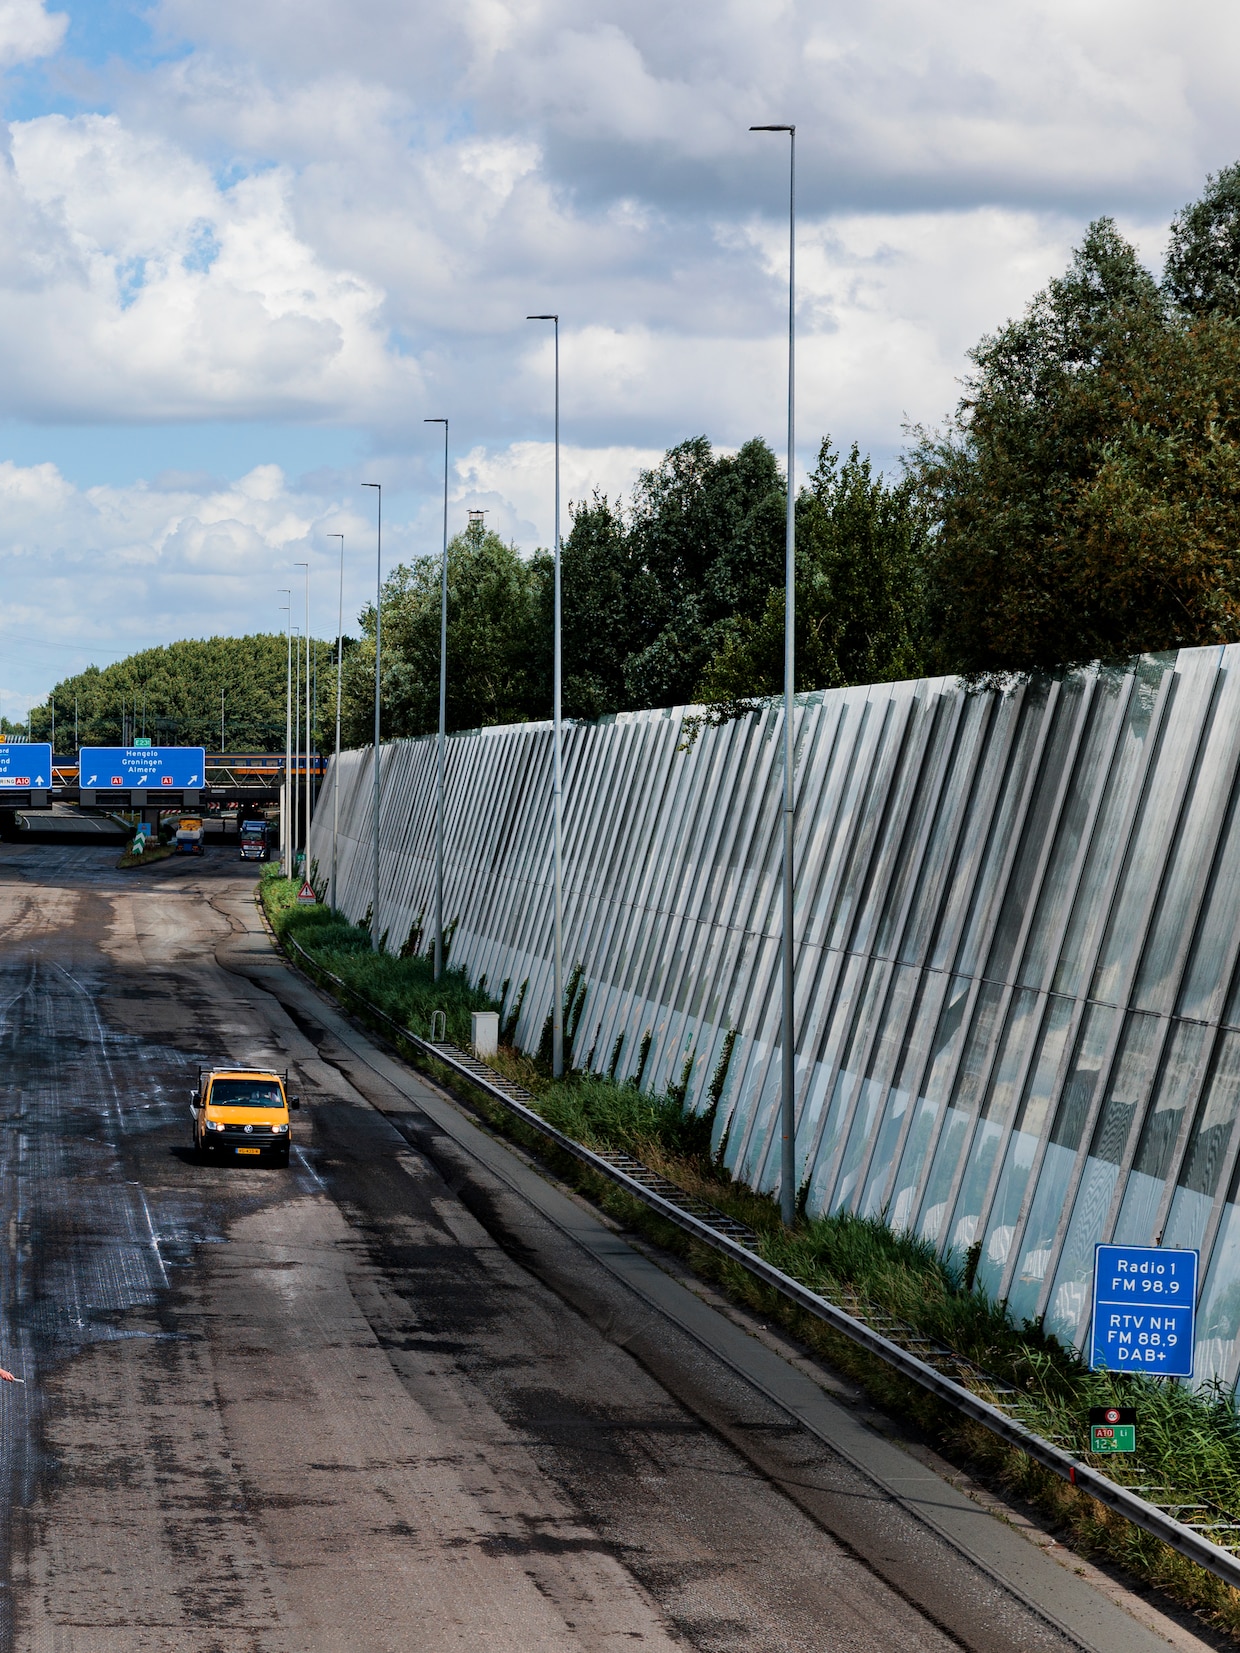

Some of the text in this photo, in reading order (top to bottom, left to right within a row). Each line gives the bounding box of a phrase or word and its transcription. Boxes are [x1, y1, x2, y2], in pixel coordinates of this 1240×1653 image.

[126, 750, 158, 758] Hengelo
[1117, 1259, 1176, 1275] Radio 1
[1112, 1278, 1136, 1292] FM
[1110, 1314, 1176, 1331] RTV NH
[1107, 1330, 1131, 1344] FM
[1118, 1347, 1167, 1362] DAB+
